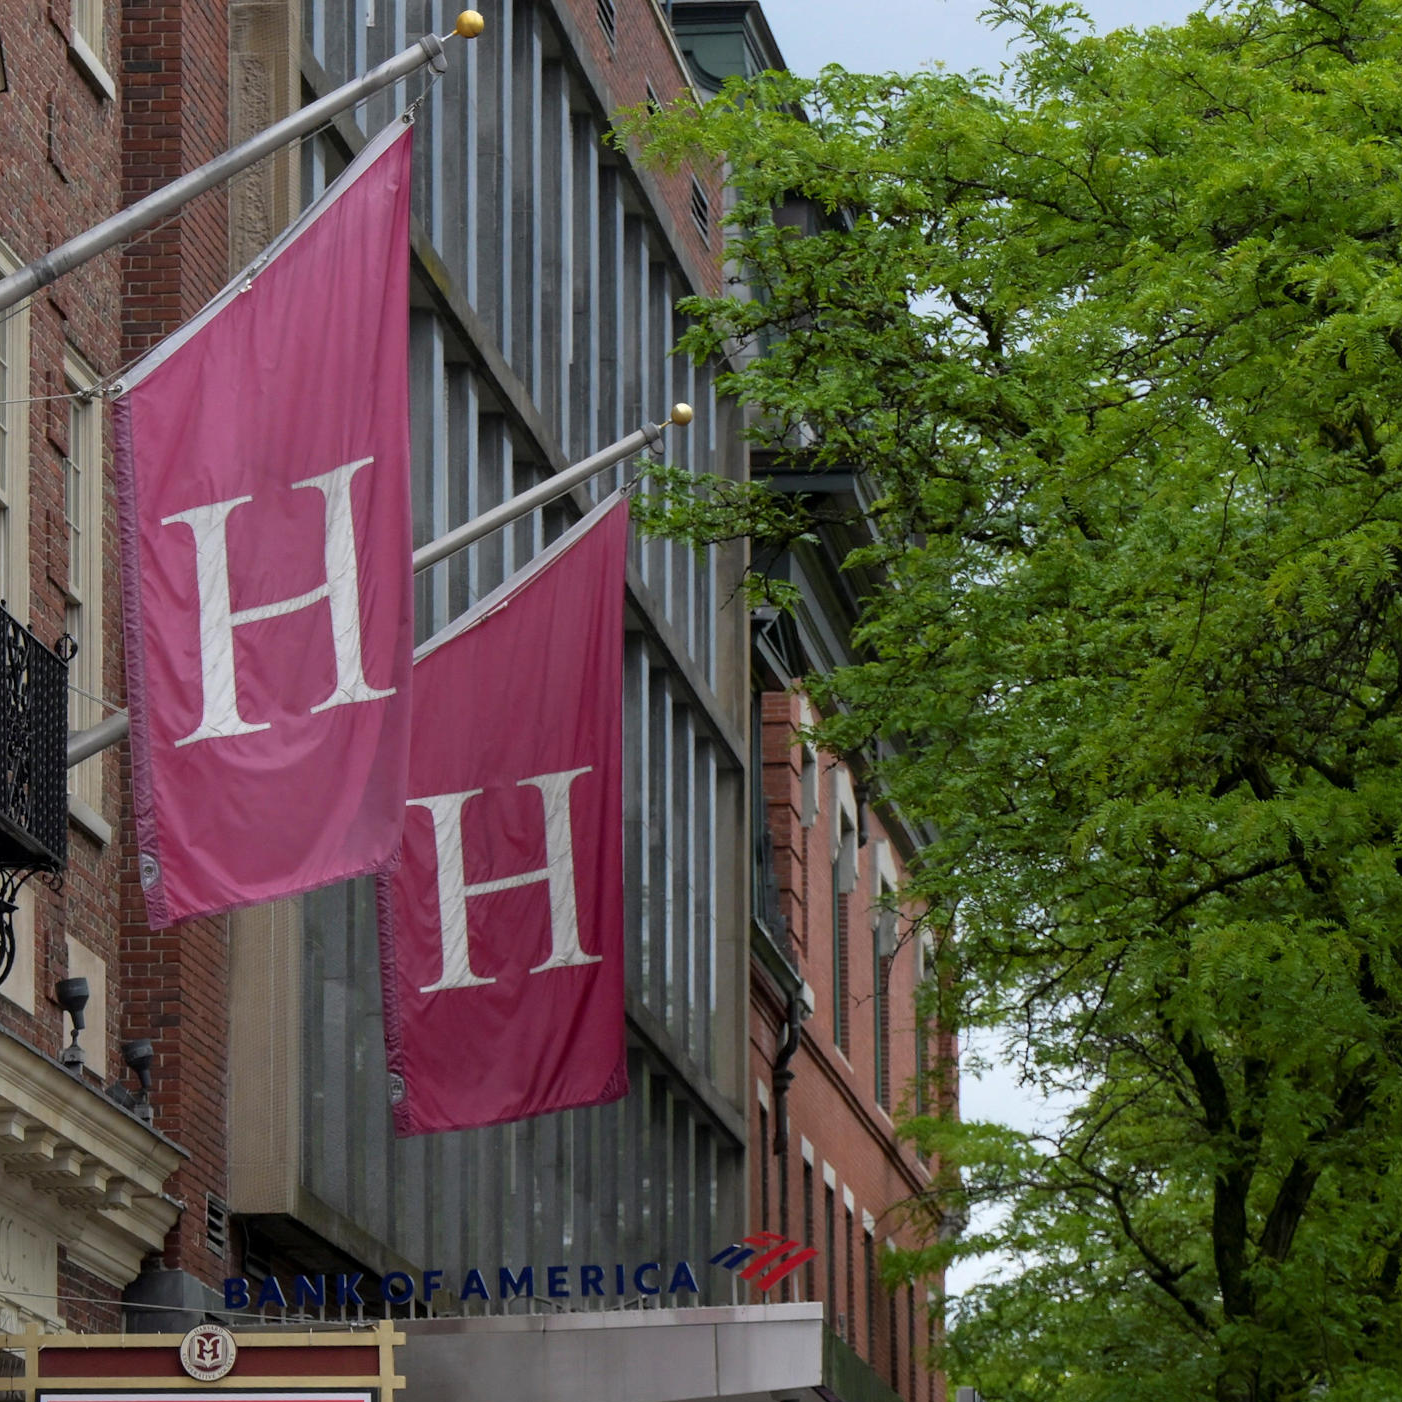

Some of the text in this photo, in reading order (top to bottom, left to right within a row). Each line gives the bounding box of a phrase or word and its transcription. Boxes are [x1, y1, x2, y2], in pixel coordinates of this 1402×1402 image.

[161, 456, 396, 747] H
[405, 767, 602, 993] H
[224, 1262, 699, 1310] BANK OF AMERICA
